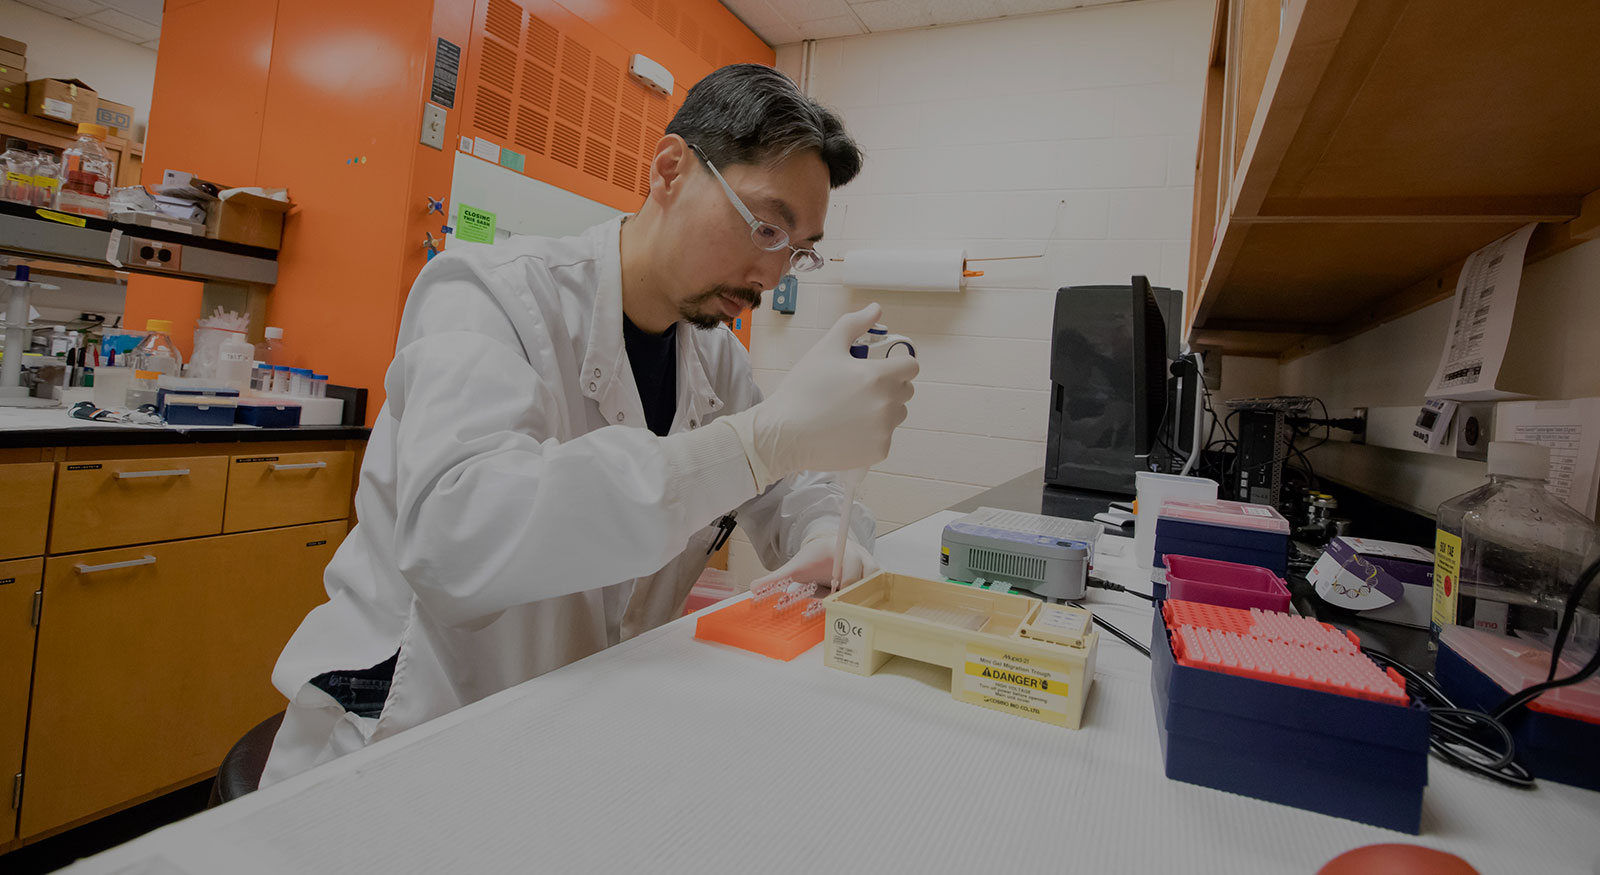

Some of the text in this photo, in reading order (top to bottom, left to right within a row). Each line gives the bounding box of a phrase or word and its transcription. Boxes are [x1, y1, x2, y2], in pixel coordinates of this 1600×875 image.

[464, 210, 490, 222] CLOSING
[852, 626, 862, 637] CE
[1003, 662, 1030, 673] Migration
[1031, 666, 1051, 678] Trough
[993, 670, 1038, 688] DANGER
[979, 682, 990, 690] Turn
[997, 687, 1012, 695] power
[1013, 690, 1028, 698] before
[1028, 694, 1048, 704] opening
[1008, 684, 1031, 694] VOLTAGE
